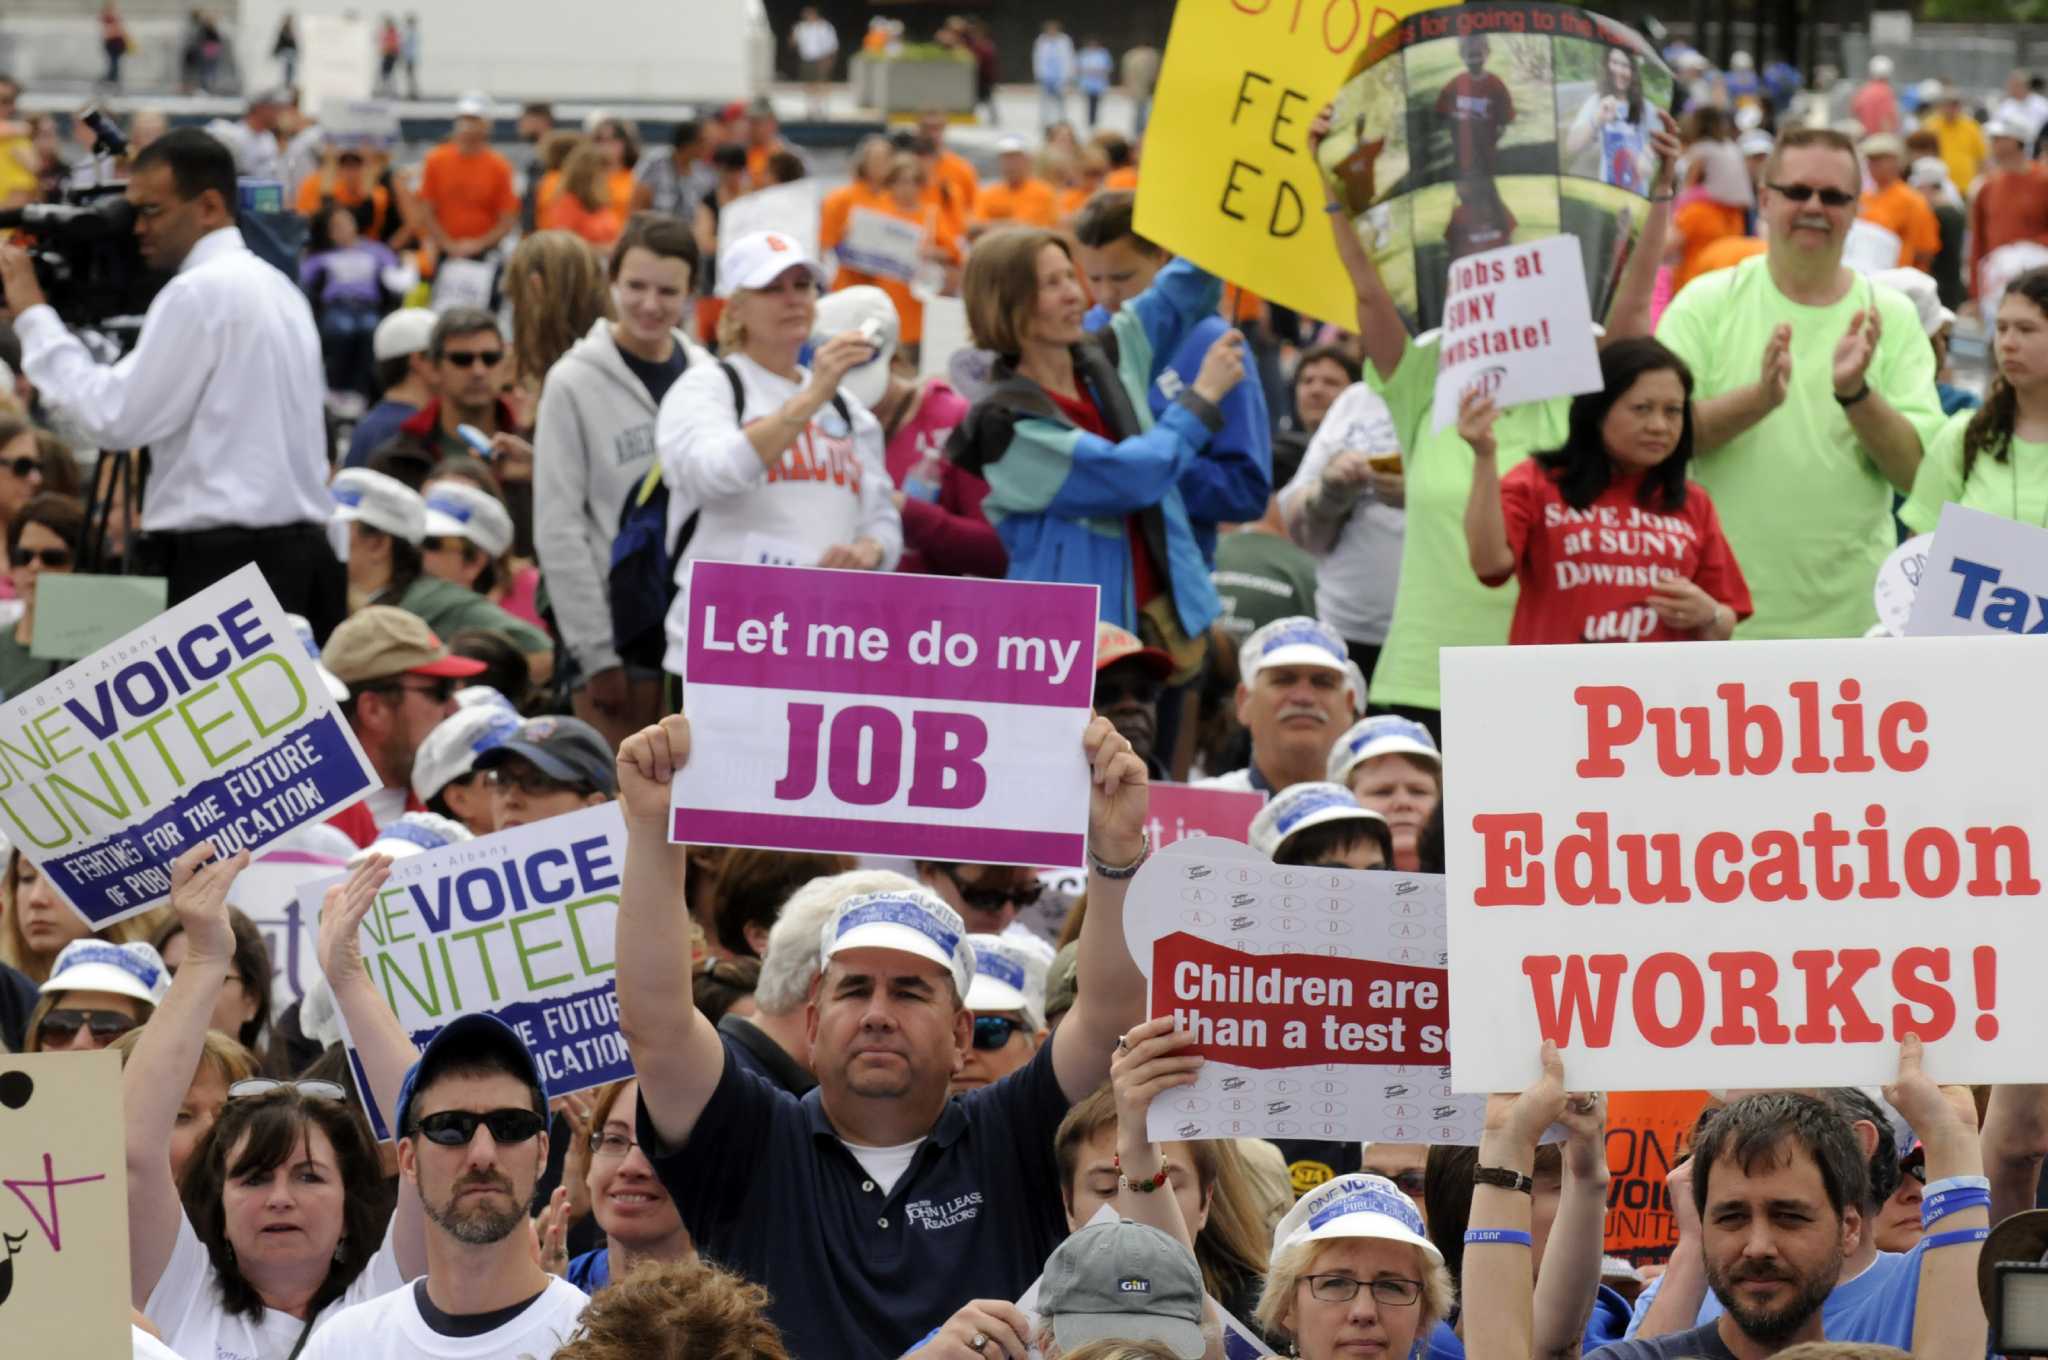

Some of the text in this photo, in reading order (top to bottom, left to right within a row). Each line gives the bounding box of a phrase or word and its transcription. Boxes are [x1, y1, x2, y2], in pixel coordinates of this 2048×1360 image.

[1457, 9, 1525, 31] going
[1531, 9, 1555, 29] to
[1515, 250, 1544, 278] at
[1563, 528, 1689, 560] at SUNY
[100, 633, 159, 672] Albany
[703, 605, 1081, 685] Let me do my
[0, 598, 275, 791] NE VOICE
[1574, 678, 1930, 779] Public
[0, 653, 308, 850] UNITED
[774, 702, 989, 810] JOB
[142, 821, 185, 857] FOR
[183, 795, 226, 832] THE
[224, 734, 323, 807] FUTURE
[105, 884, 129, 908] OF
[200, 777, 325, 867] DUCATION
[1472, 803, 2041, 907] Education
[360, 834, 621, 947] NE VOICE
[361, 893, 621, 1018] NITED
[1173, 960, 1439, 1010] Children are
[542, 991, 620, 1039] FUTUR
[1172, 1008, 1268, 1048] than
[1282, 1020, 1307, 1049] a
[1322, 1014, 1407, 1053] test
[1521, 945, 2000, 1049] WORKS!
[1605, 1128, 1682, 1177] ON
[946, 1192, 985, 1214] LEASE
[1120, 1279, 1147, 1291] Gill
